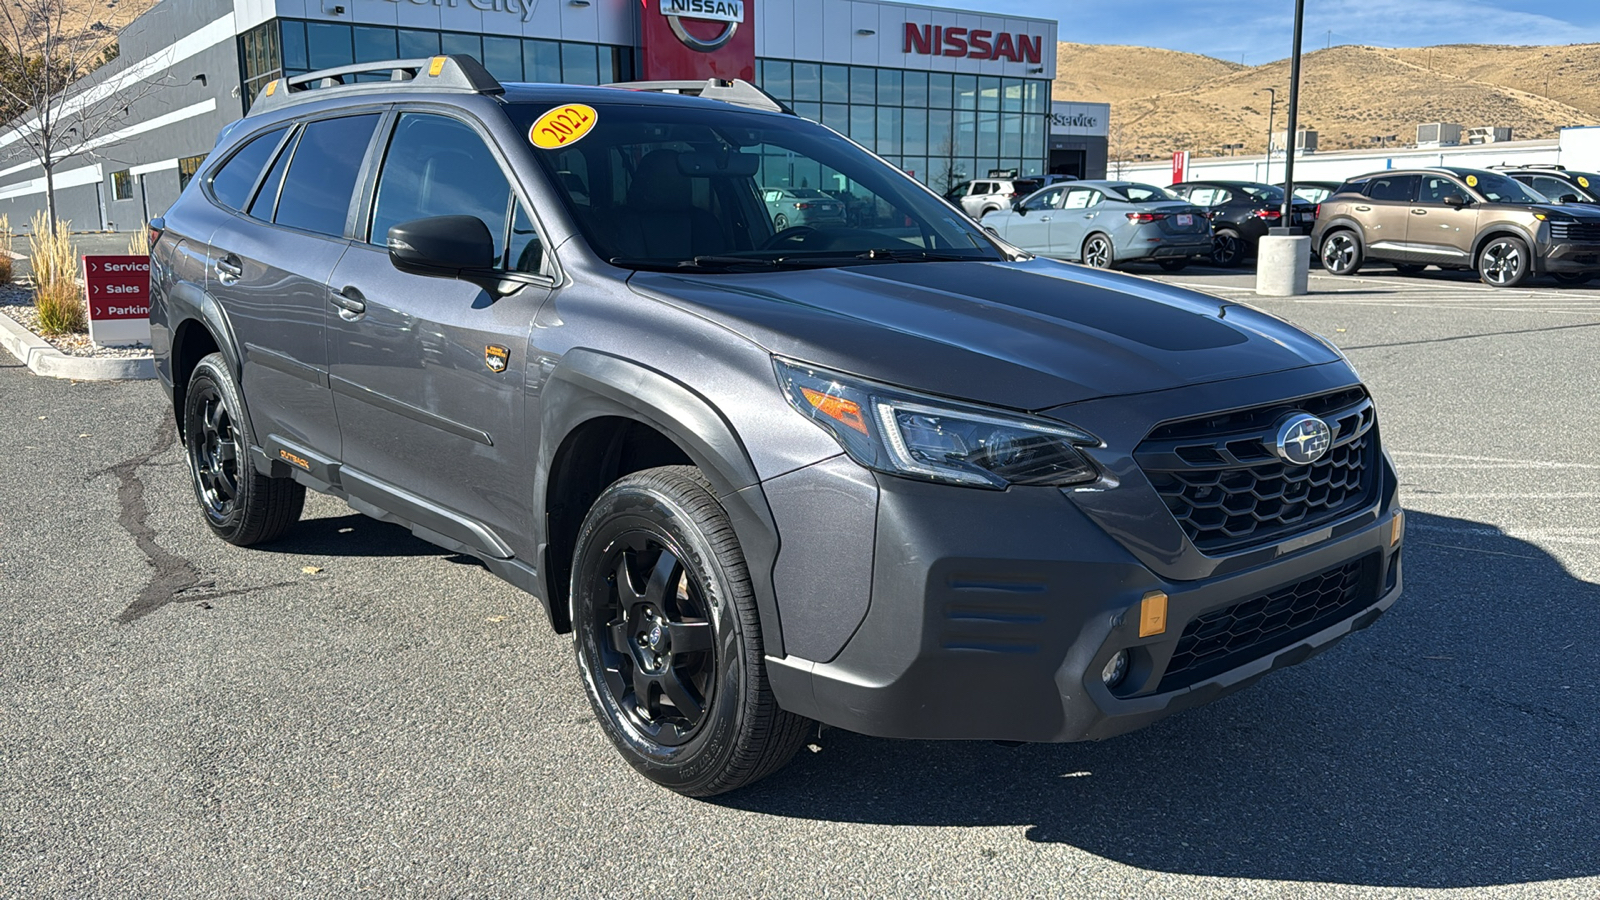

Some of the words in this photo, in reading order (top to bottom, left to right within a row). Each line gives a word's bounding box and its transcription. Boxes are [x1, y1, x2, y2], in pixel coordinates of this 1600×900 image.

[671, 0, 739, 17] NISSAN
[903, 22, 1042, 64] NISSAN
[541, 108, 589, 143] 2022
[1053, 112, 1098, 127] Service
[104, 262, 150, 272] Service
[106, 284, 140, 294] Sales
